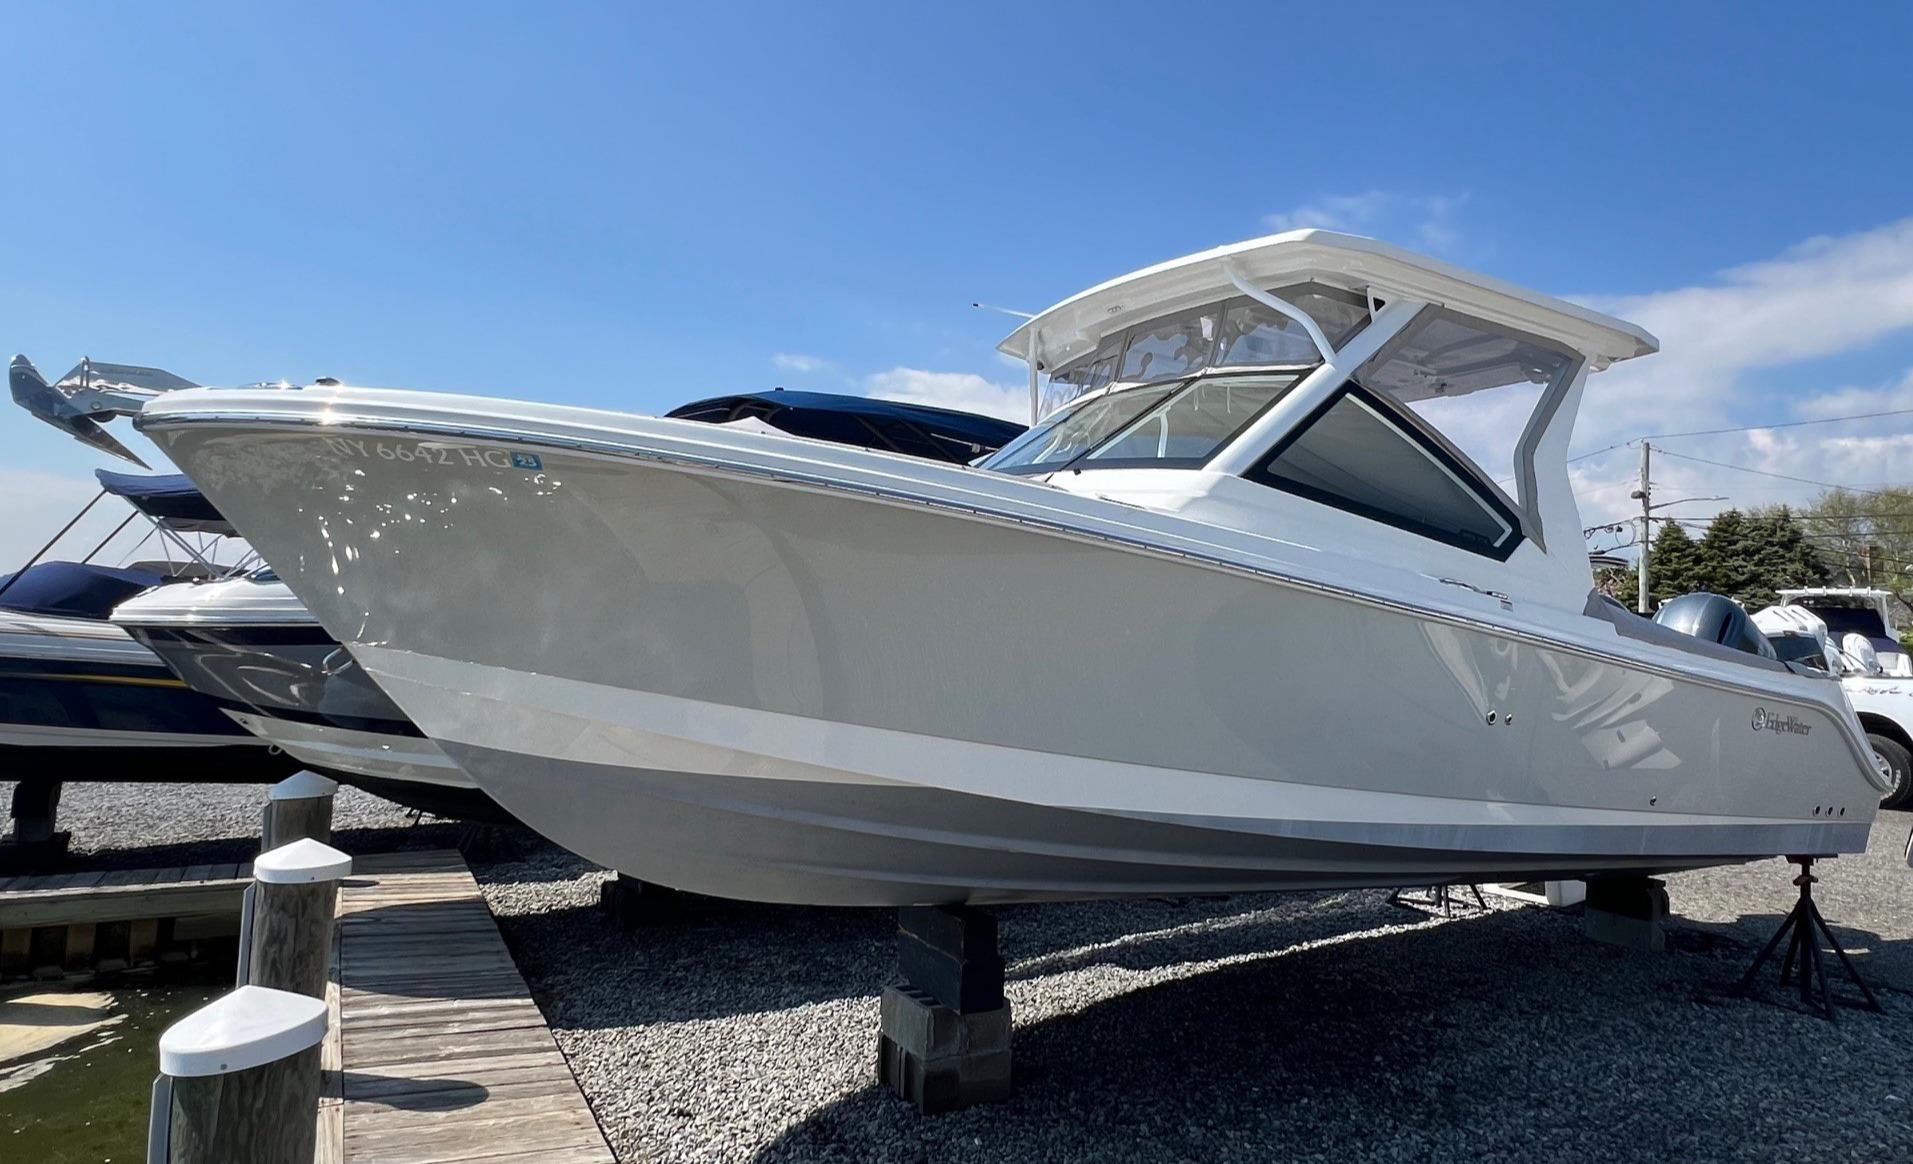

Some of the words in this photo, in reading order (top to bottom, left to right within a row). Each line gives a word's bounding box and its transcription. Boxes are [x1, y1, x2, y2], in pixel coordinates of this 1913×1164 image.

[323, 437, 369, 458] NY
[376, 442, 455, 465] 6642
[458, 448, 511, 469] HG
